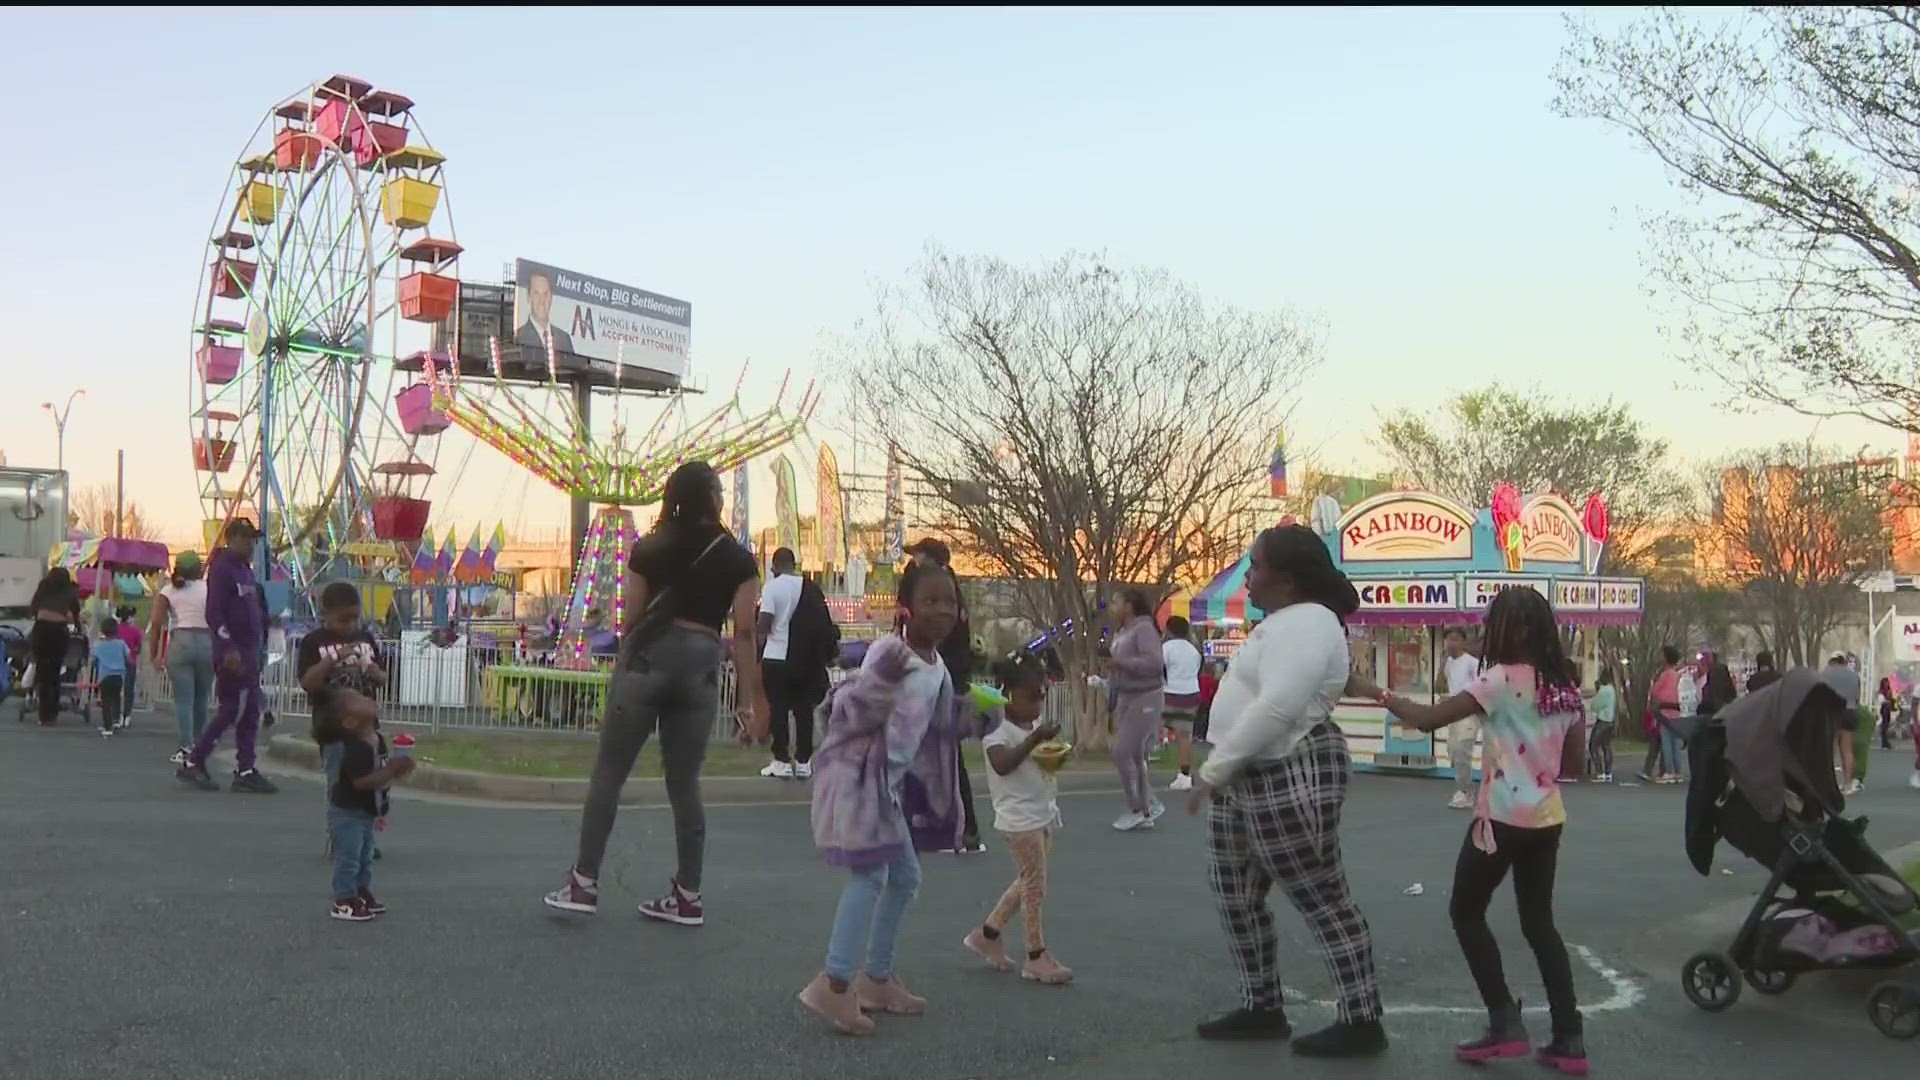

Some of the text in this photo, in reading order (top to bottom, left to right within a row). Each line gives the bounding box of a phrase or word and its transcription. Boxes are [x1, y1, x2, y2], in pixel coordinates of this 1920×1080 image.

[556, 274, 685, 318] Next Stop, BIG Settlement!
[1347, 512, 1465, 546] RAINBOW
[1522, 512, 1578, 551] RAINBOW
[1362, 584, 1449, 604] CREAM
[1556, 585, 1596, 604] ICE CREAM
